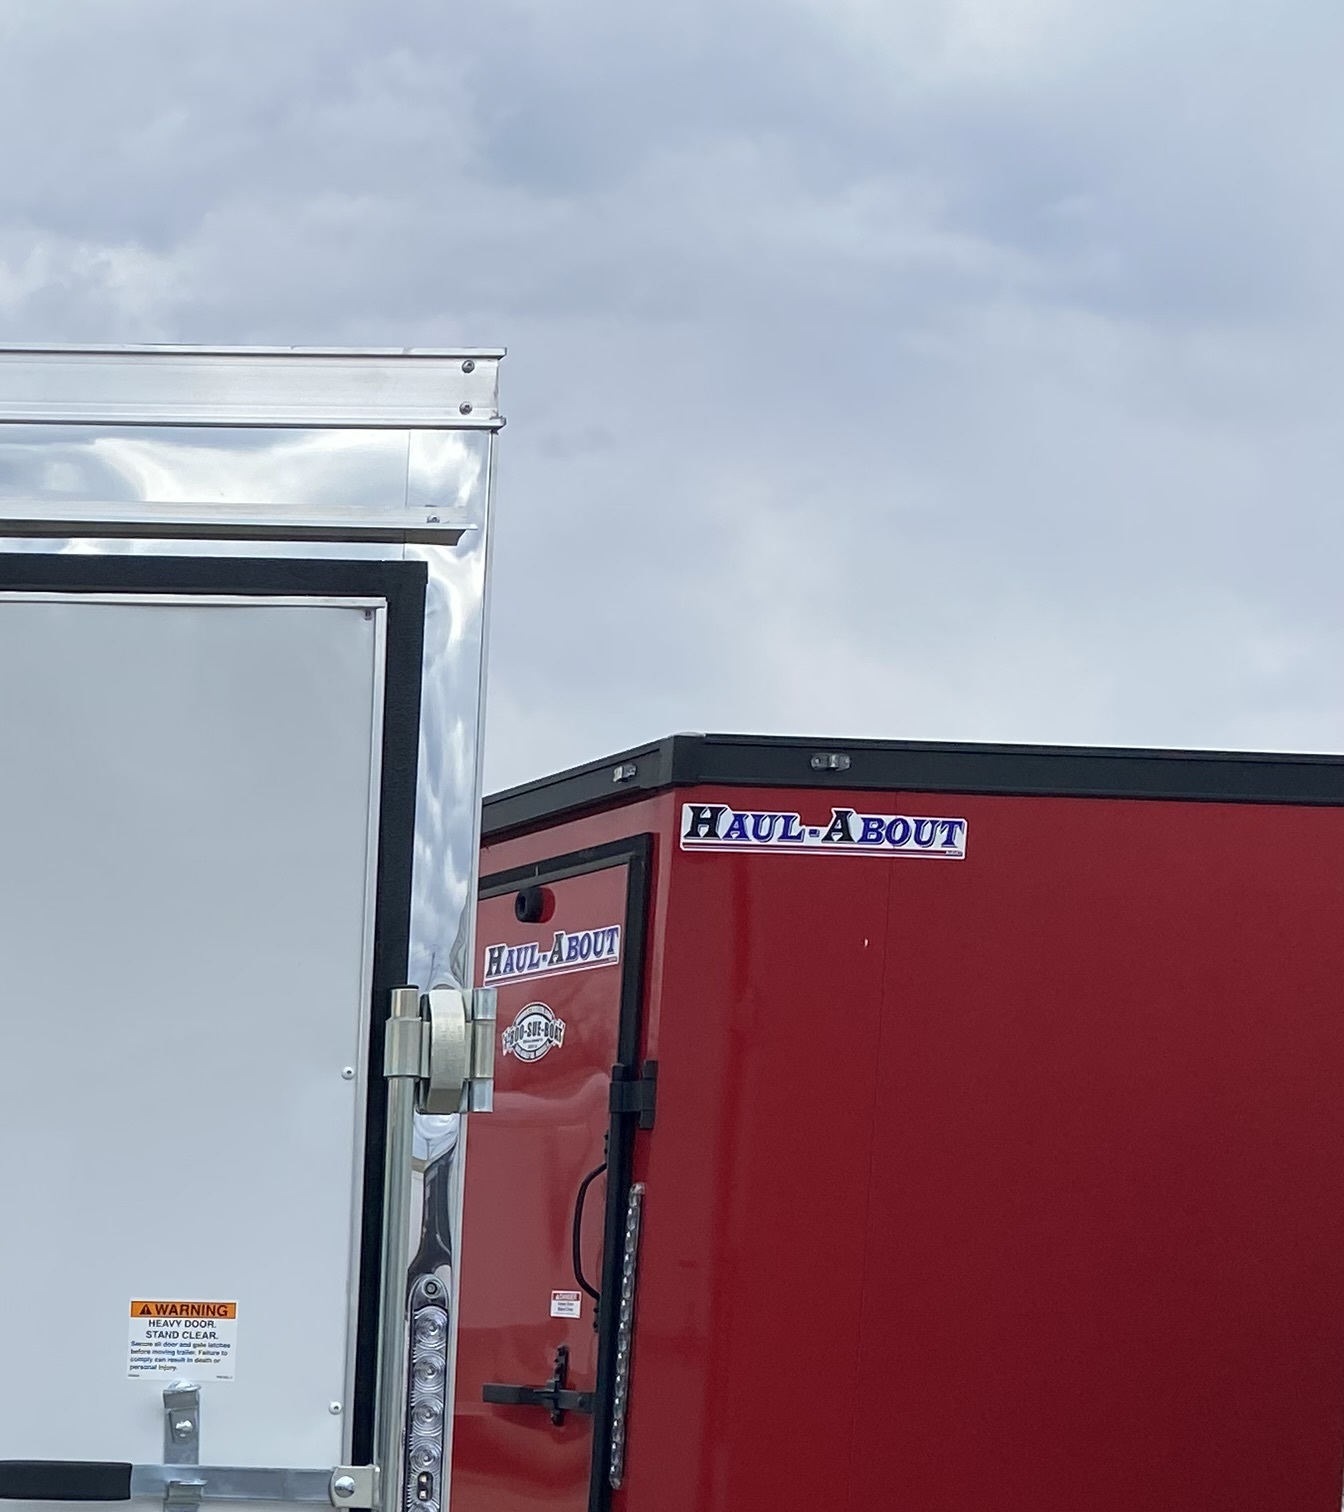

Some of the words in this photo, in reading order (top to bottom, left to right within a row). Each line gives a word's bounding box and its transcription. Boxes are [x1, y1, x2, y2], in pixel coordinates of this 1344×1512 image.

[683, 805, 965, 849] HAUL-ABOUT
[486, 926, 619, 979] HAUL-ABOUT
[155, 1304, 228, 1317] WARNING
[148, 1320, 182, 1328] HEAVY
[184, 1320, 216, 1328] DOOR.
[146, 1331, 179, 1339] STAND
[182, 1331, 218, 1340] CLEAR.
